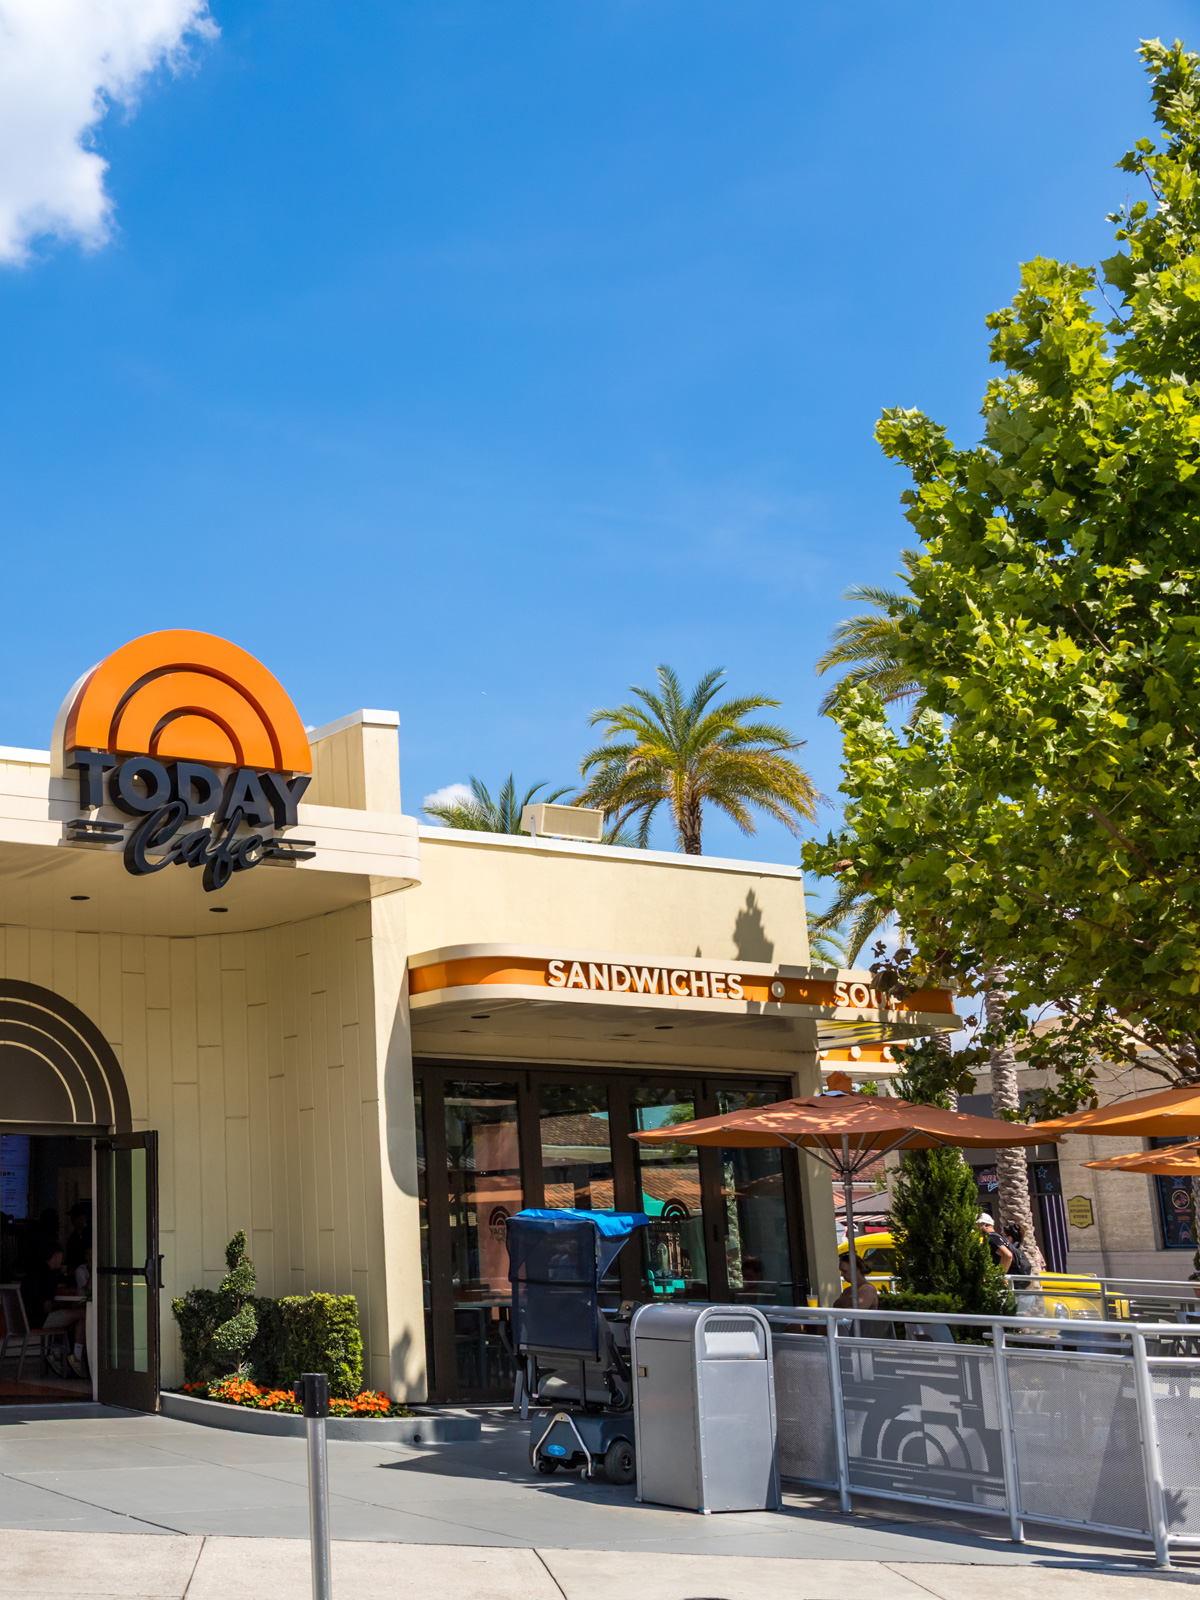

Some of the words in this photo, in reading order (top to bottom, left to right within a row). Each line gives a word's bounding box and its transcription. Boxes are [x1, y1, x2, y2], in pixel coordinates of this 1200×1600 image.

[66, 750, 312, 831] TODAY
[123, 801, 267, 893] Cafe
[547, 960, 744, 1000] SANDWICHES
